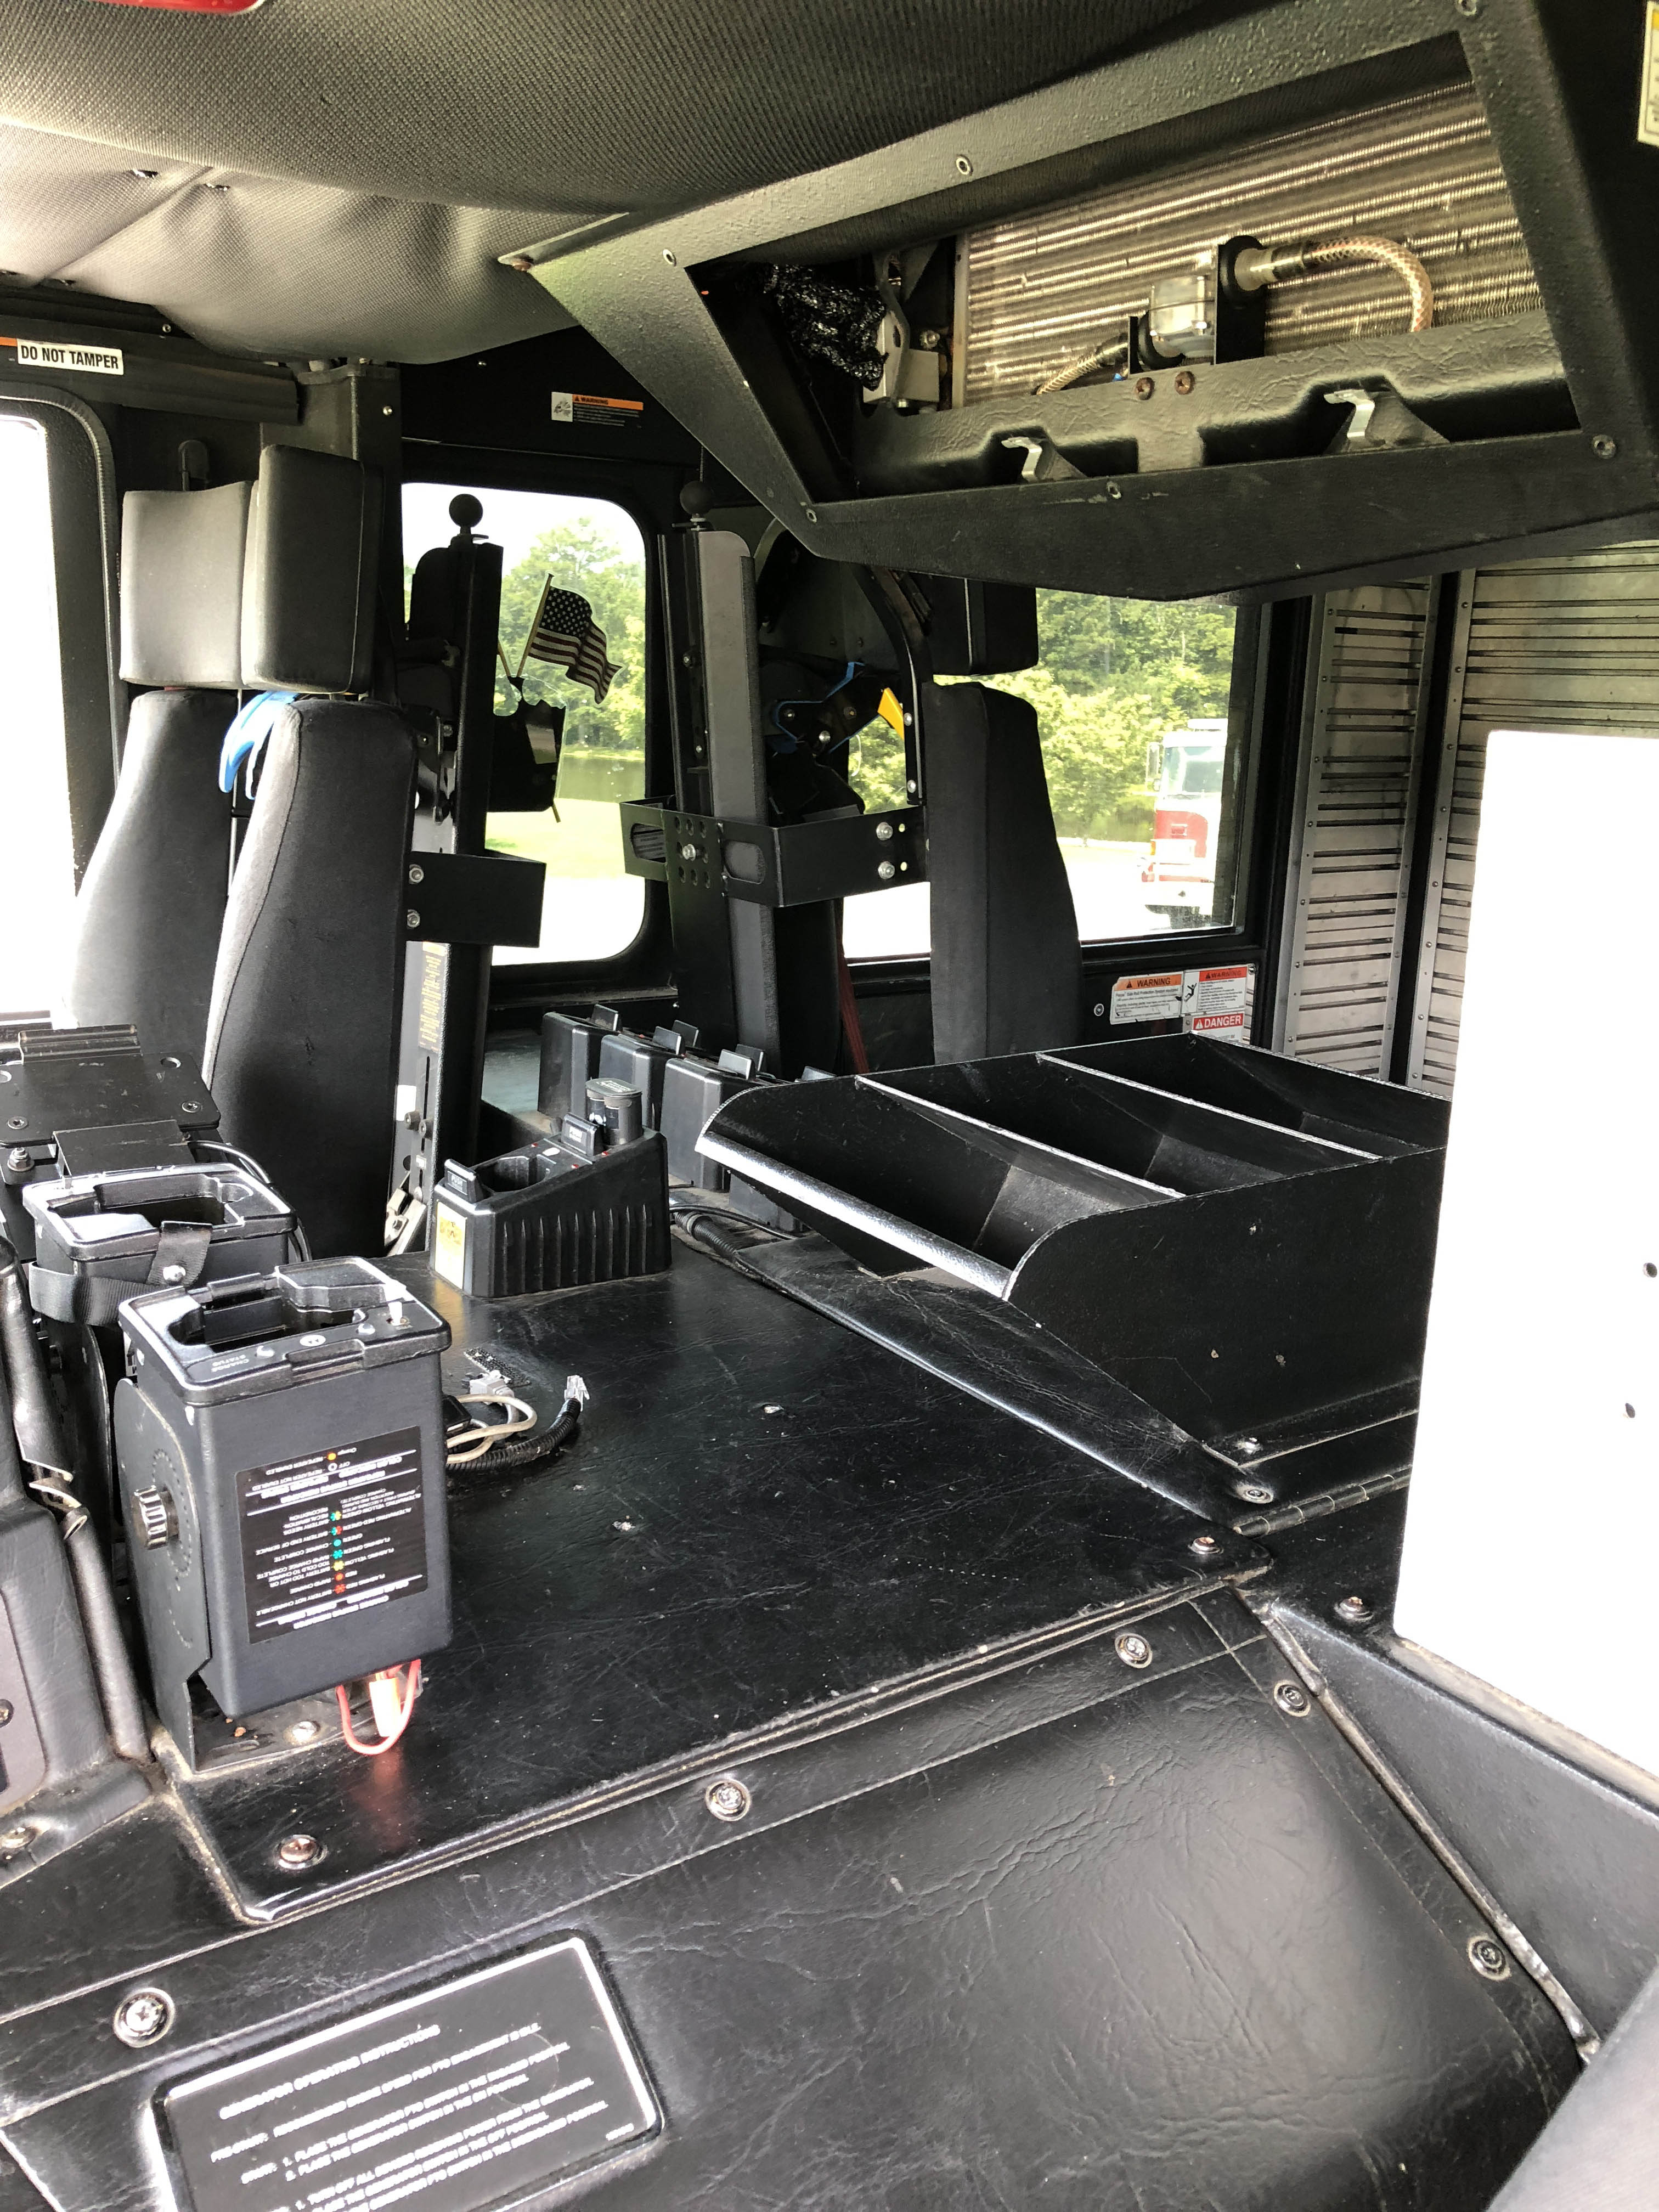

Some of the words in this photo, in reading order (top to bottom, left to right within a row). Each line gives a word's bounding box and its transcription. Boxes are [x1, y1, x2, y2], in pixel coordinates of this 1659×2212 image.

[21, 345, 37, 360] DO
[42, 347, 65, 363] NOT
[69, 351, 119, 369] TAMPER
[581, 397, 608, 405] WARNING
[1211, 970, 1242, 978] WARNING
[1137, 977, 1171, 988] WARNING
[1204, 1015, 1241, 1028] DANGER
